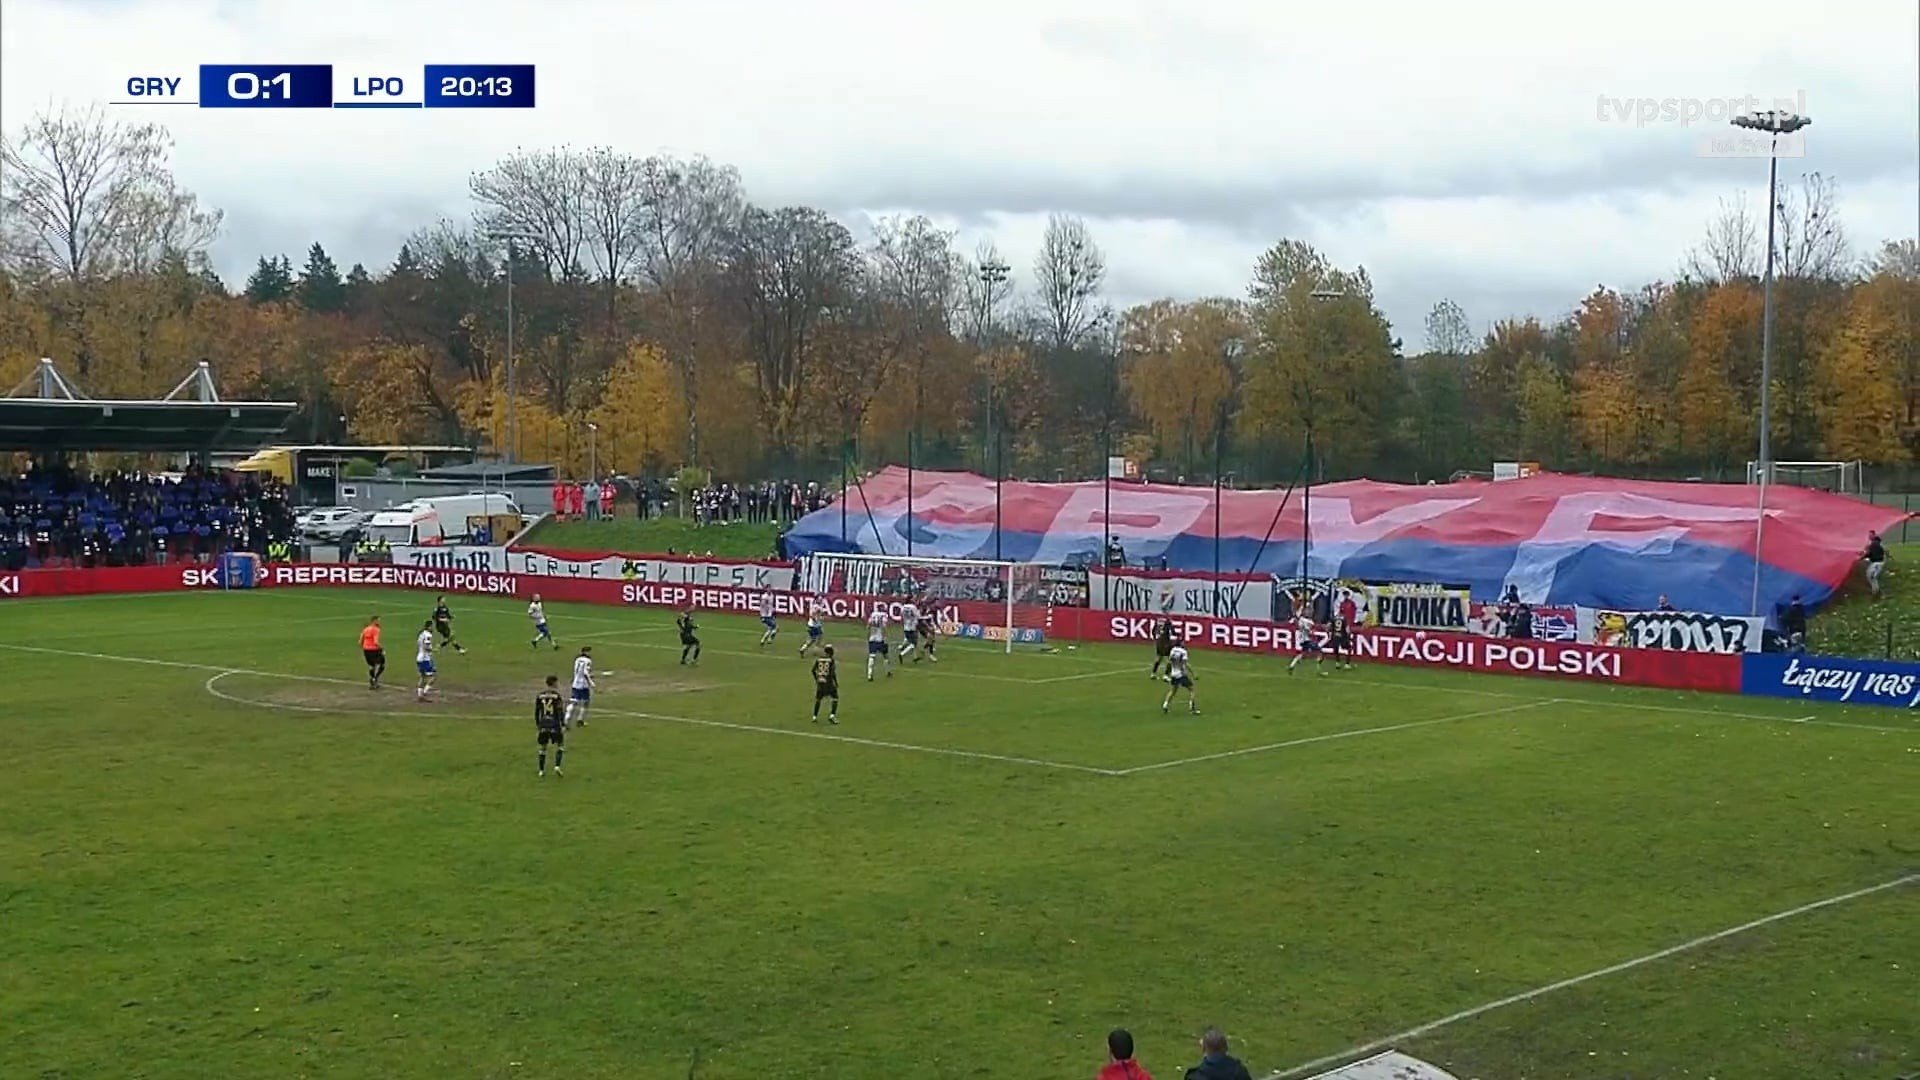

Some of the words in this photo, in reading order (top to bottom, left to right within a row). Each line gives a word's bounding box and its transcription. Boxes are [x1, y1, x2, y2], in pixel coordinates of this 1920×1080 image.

[307, 466, 331, 478] MAKE
[276, 566, 450, 589] REPREZENTACJI
[454, 574, 517, 594] POLSKI
[1113, 576, 1153, 612] GRYF
[622, 585, 687, 605] SKLEP
[691, 590, 865, 620] REPREENTACJI
[1377, 595, 1466, 628] POMKA
[1485, 643, 1621, 677] POLSKI
[1782, 658, 1860, 703] Łączy
[1863, 670, 1915, 697] nas
[541, 698, 554, 716] 14
